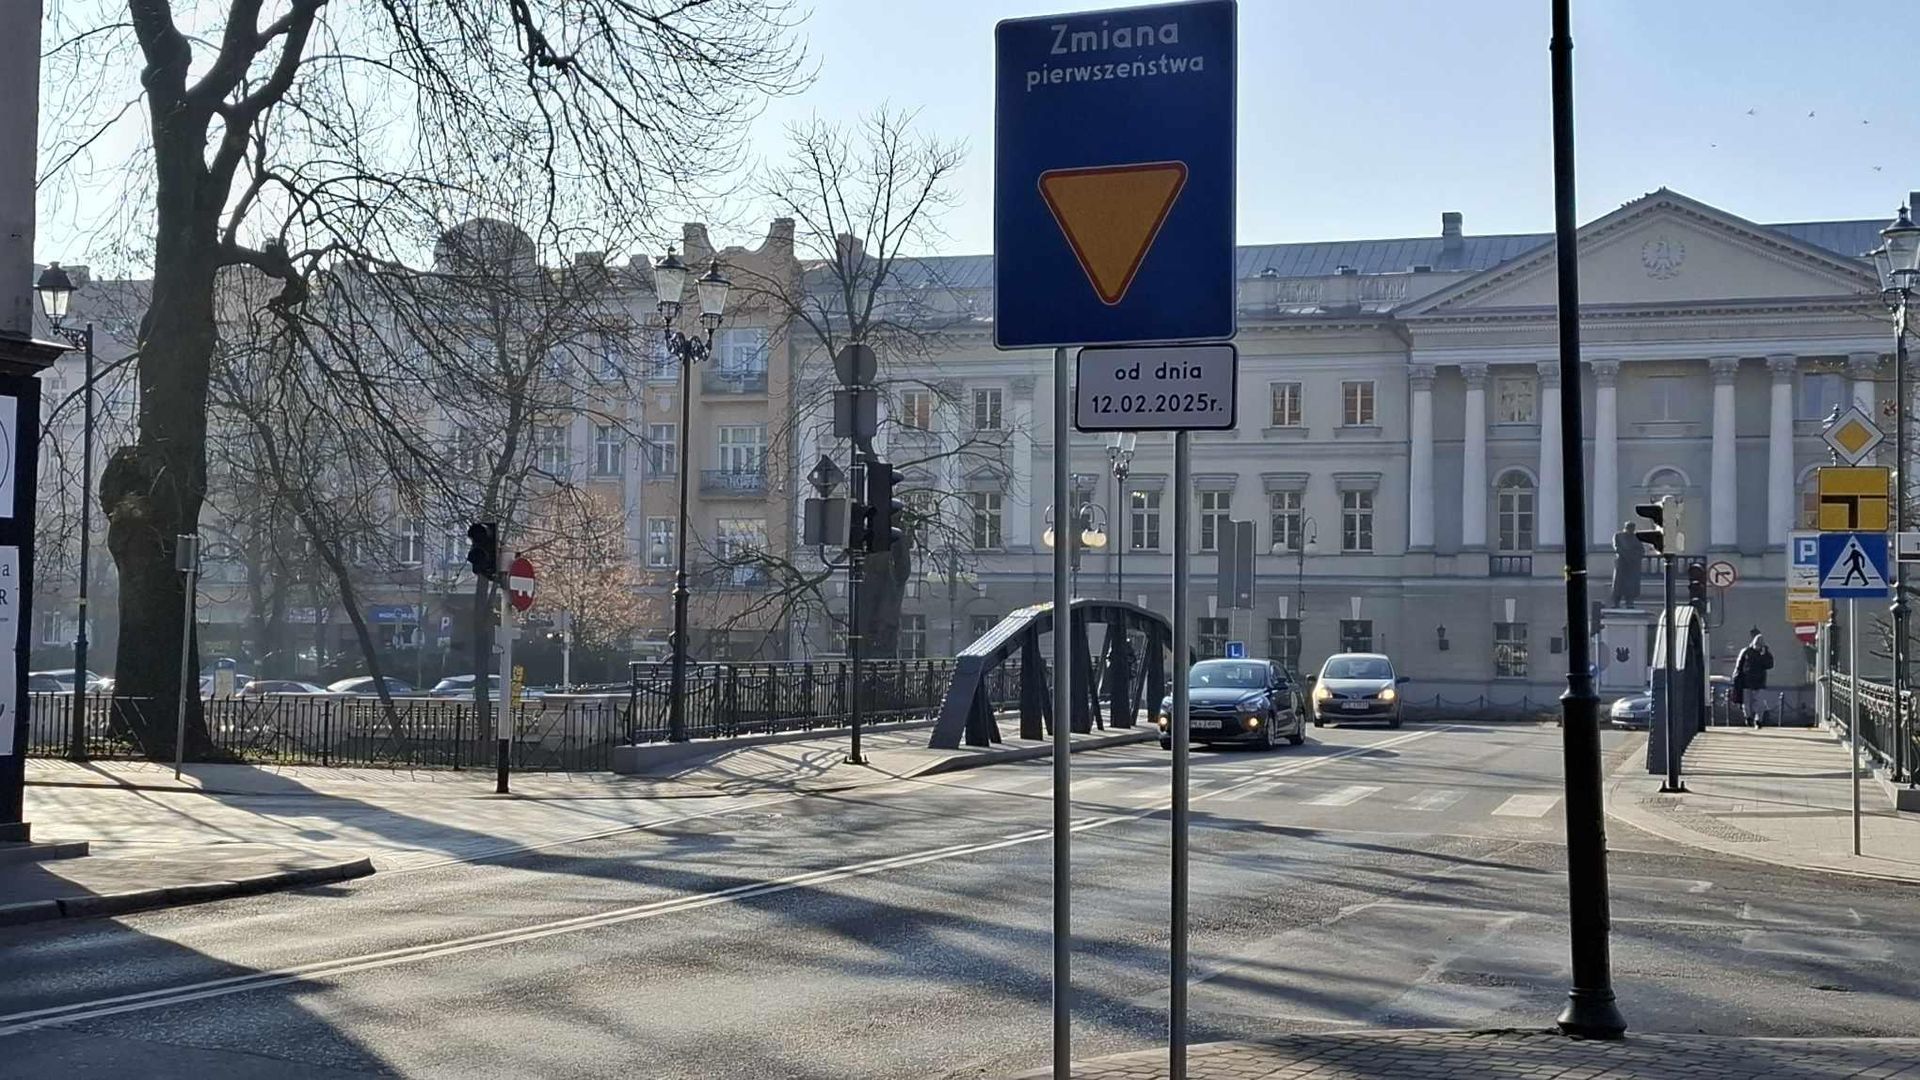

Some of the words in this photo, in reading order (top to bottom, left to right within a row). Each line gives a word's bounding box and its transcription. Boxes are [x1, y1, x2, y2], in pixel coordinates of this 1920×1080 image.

[1051, 21, 1179, 54] Zmiana
[1027, 55, 1204, 92] pierwszeństwa
[1115, 362, 1140, 380] od
[1155, 361, 1202, 380] dnia
[1092, 393, 1223, 414] 12.02.2025r.
[1800, 540, 1817, 562] P
[441, 616, 450, 630] P
[1231, 645, 1240, 657] L
